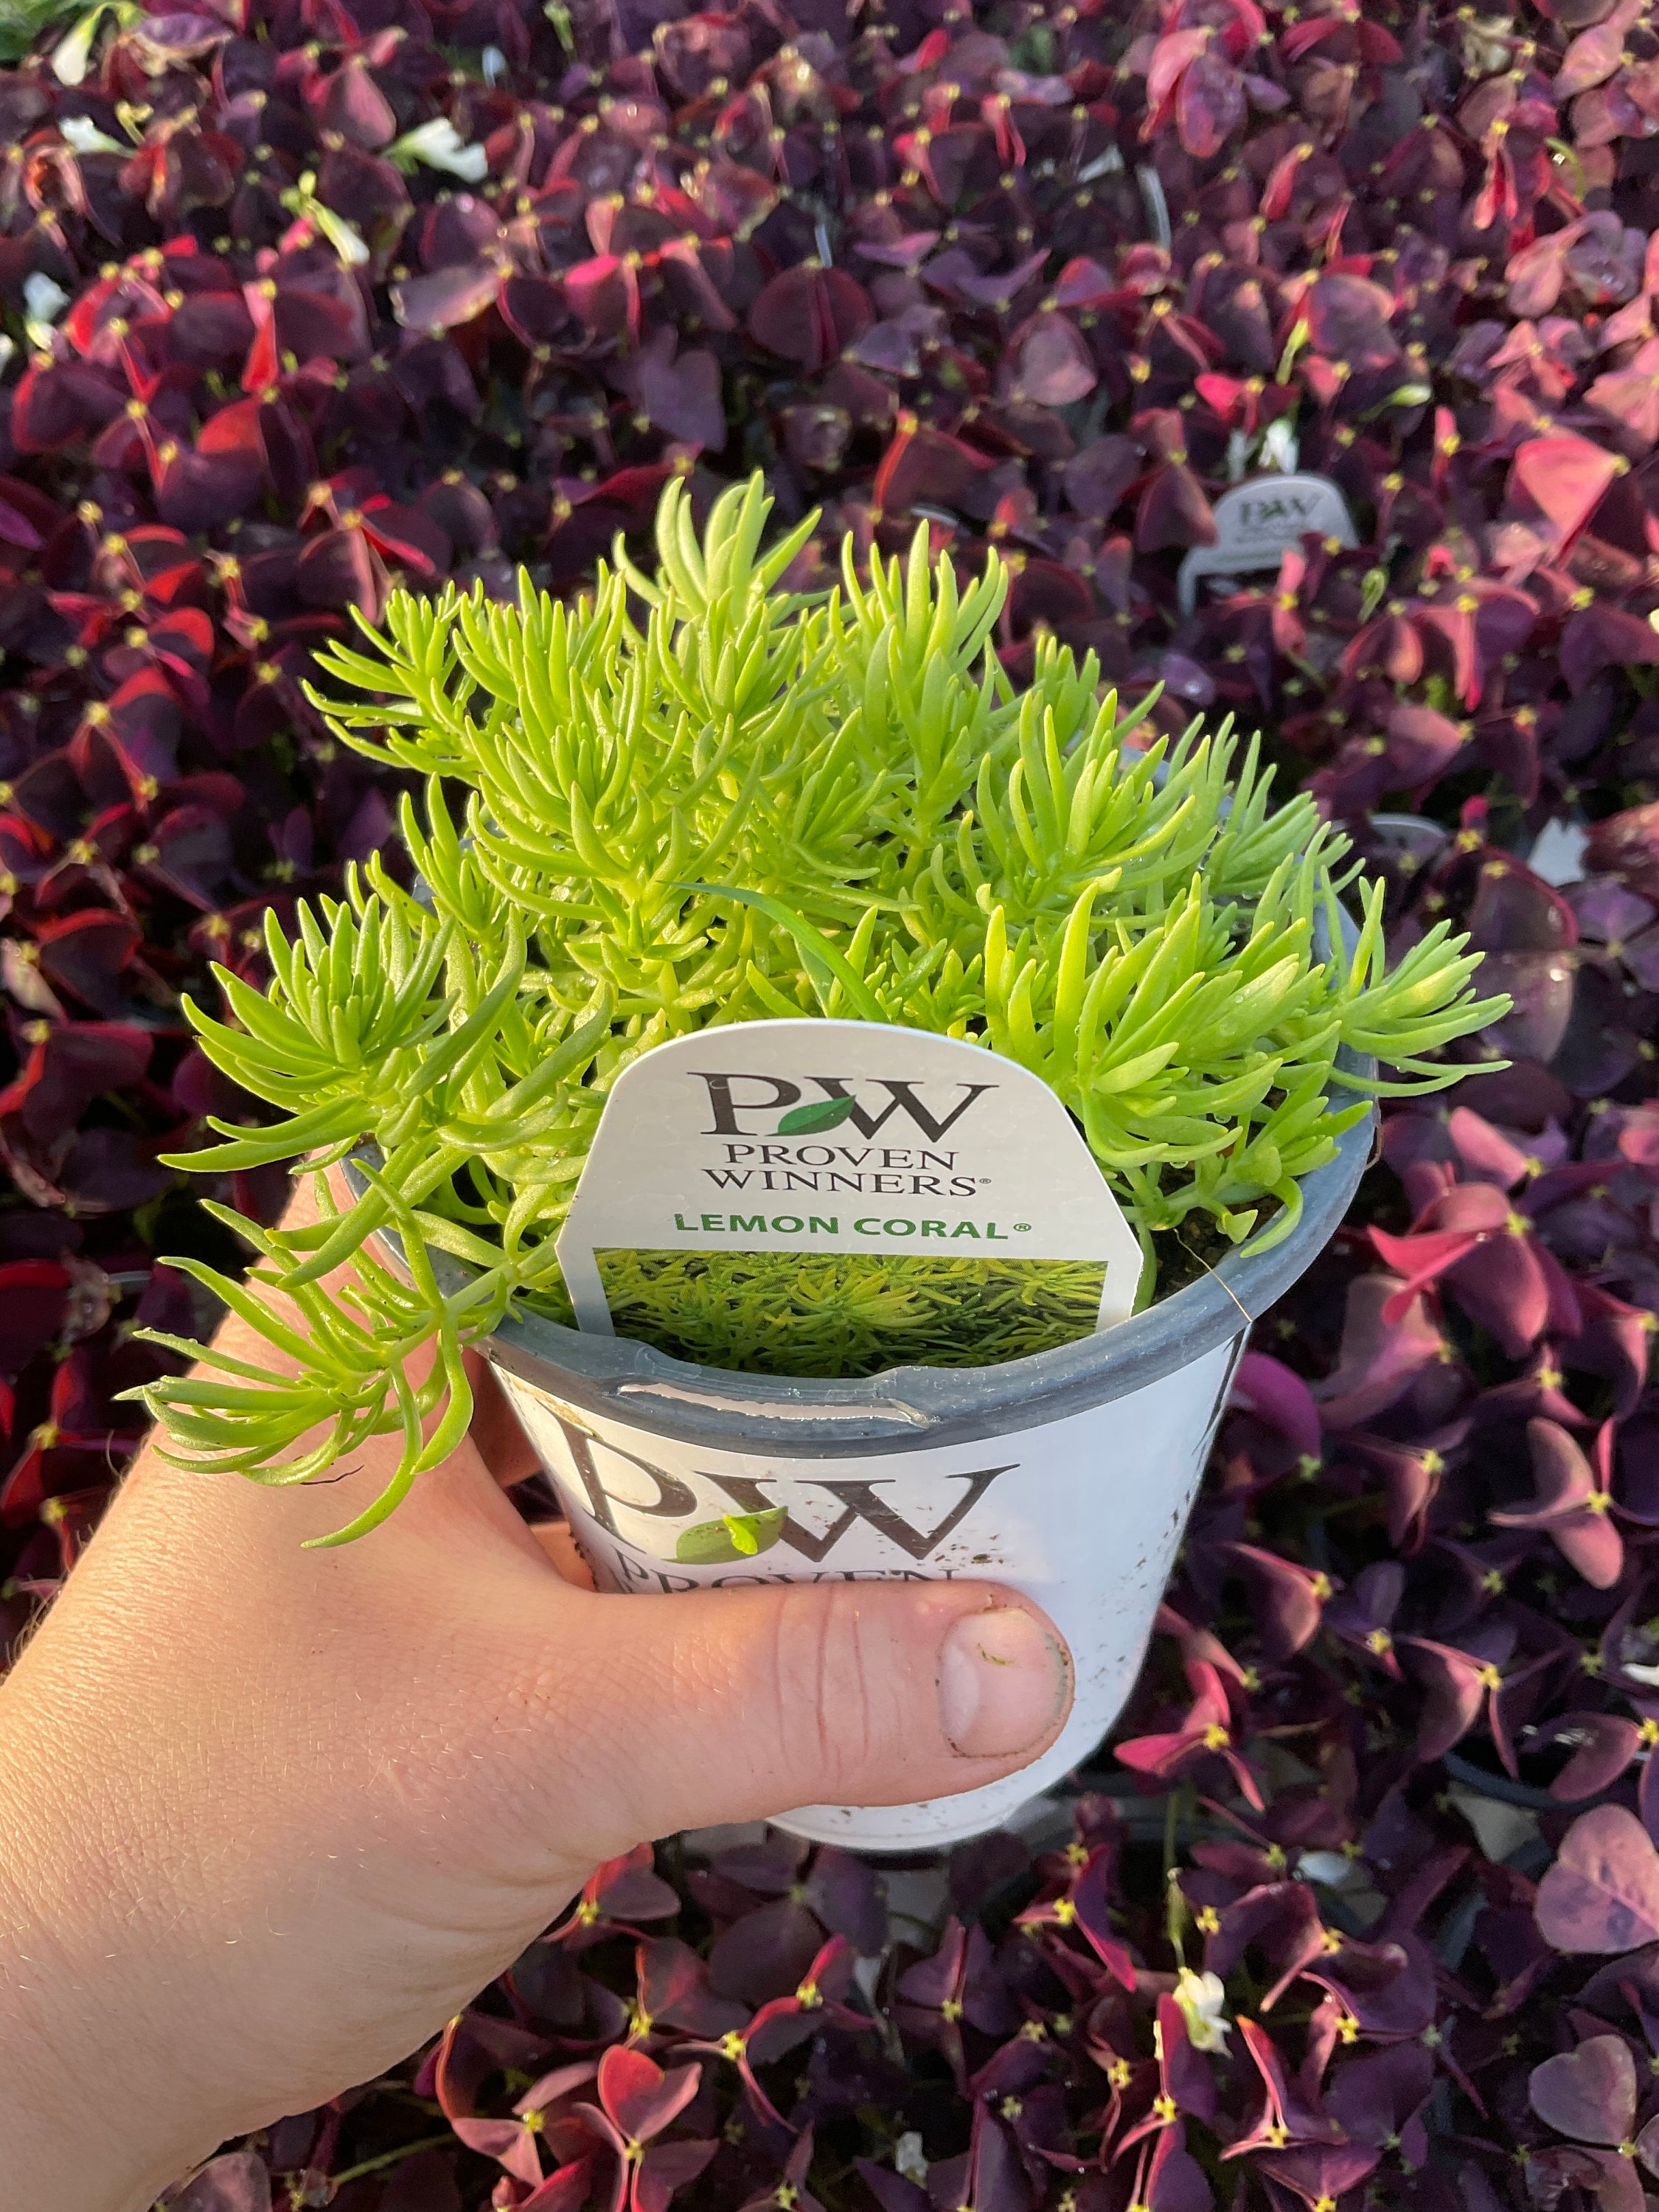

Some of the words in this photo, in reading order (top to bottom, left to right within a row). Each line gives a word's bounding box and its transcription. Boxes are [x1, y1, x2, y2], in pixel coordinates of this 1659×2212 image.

[686, 1071, 1000, 1143] PW
[722, 1143, 959, 1171] PROVEN
[674, 1213, 839, 1234] LEMON
[534, 1398, 1021, 1562] PW
